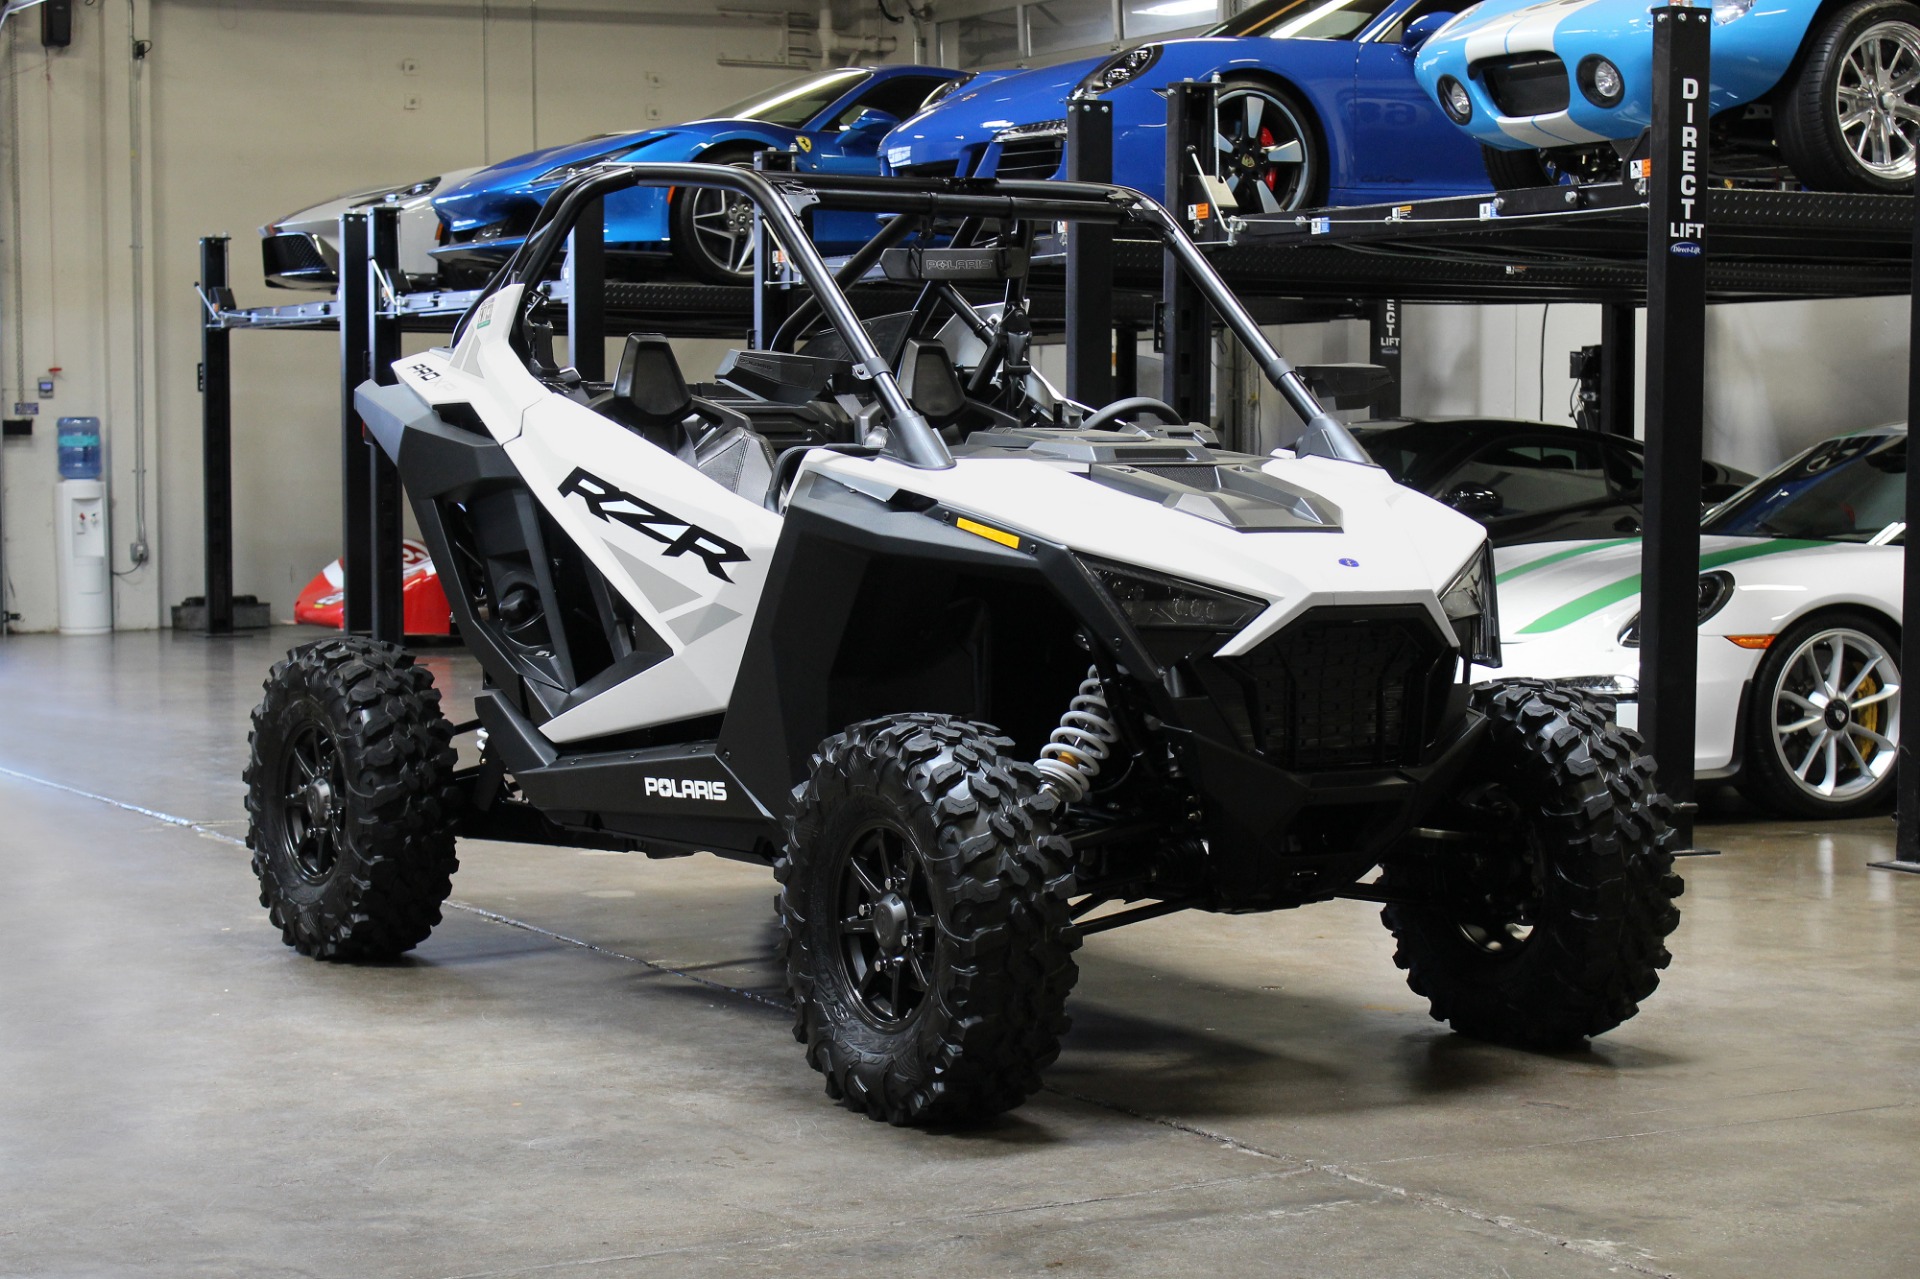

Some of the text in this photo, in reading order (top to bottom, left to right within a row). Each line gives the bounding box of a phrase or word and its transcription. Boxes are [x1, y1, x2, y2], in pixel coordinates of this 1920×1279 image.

[1680, 78, 1699, 220] DIRECT
[1670, 222, 1704, 239] LIFT
[926, 259, 992, 270] POLARIS
[1380, 337, 1400, 346] LIFT
[557, 466, 752, 584] RZR
[644, 777, 727, 801] POLARIS
